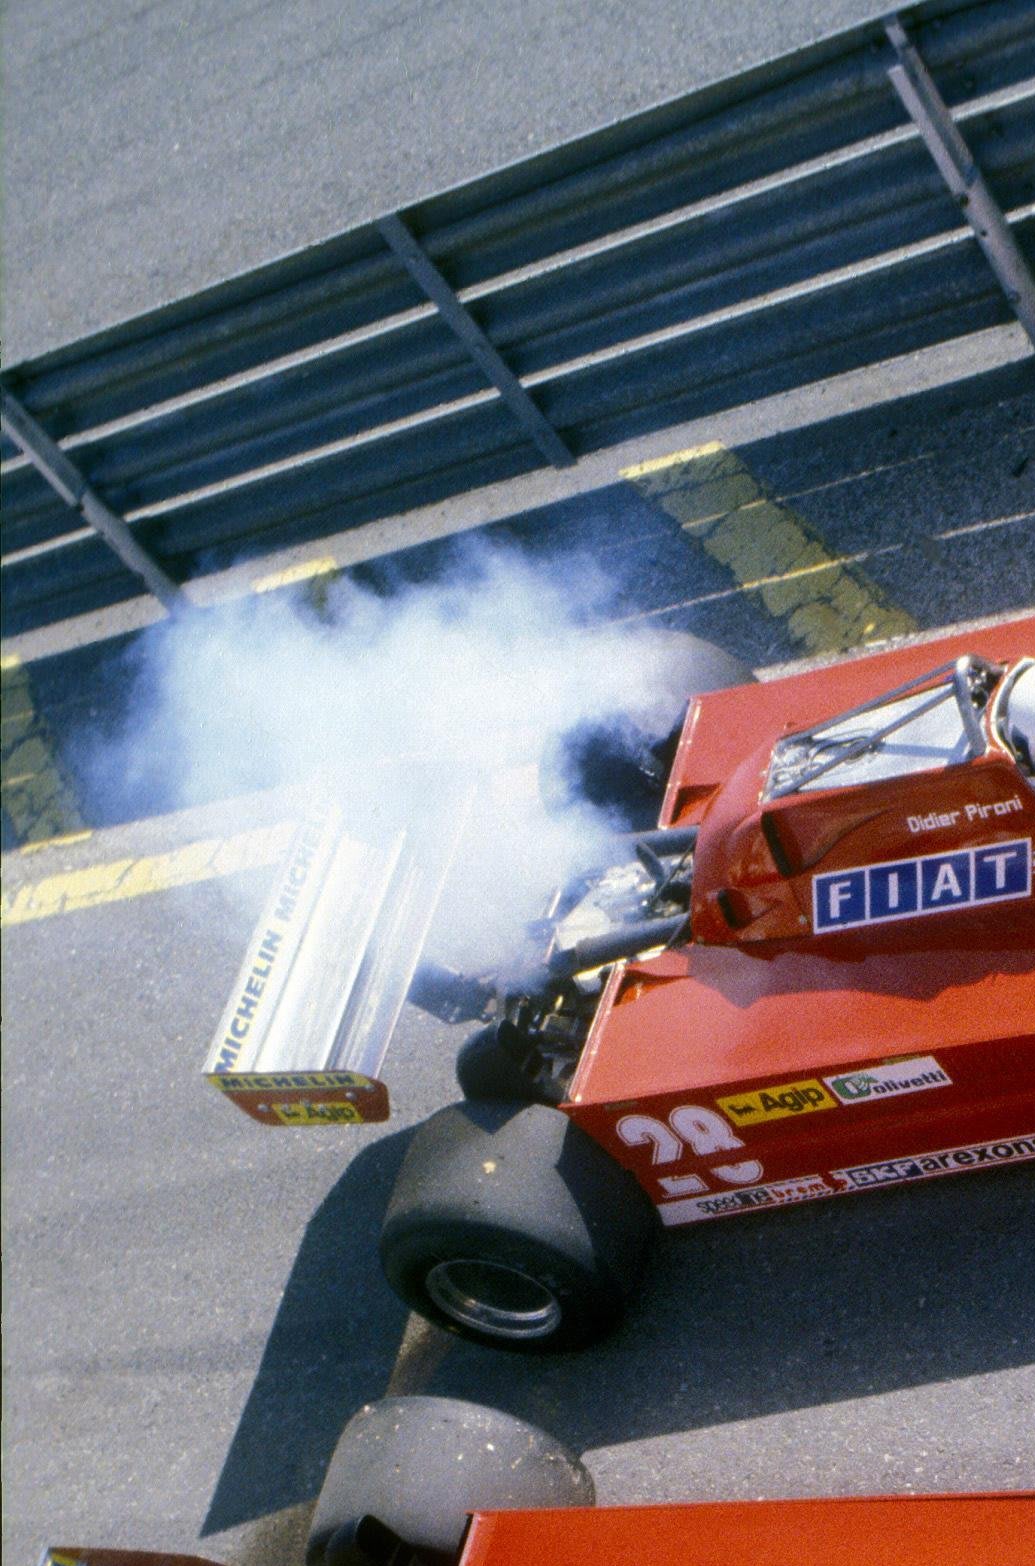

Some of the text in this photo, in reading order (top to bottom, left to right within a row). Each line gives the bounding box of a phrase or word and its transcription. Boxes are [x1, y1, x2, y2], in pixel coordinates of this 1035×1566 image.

[907, 794, 1024, 833] Didier Pironi
[828, 851, 1017, 920] FIAT
[213, 928, 283, 1074] MICHELIN
[873, 1069, 948, 1096] olivetti
[758, 1086, 825, 1114] Agip
[850, 1158, 922, 1188] SKF
